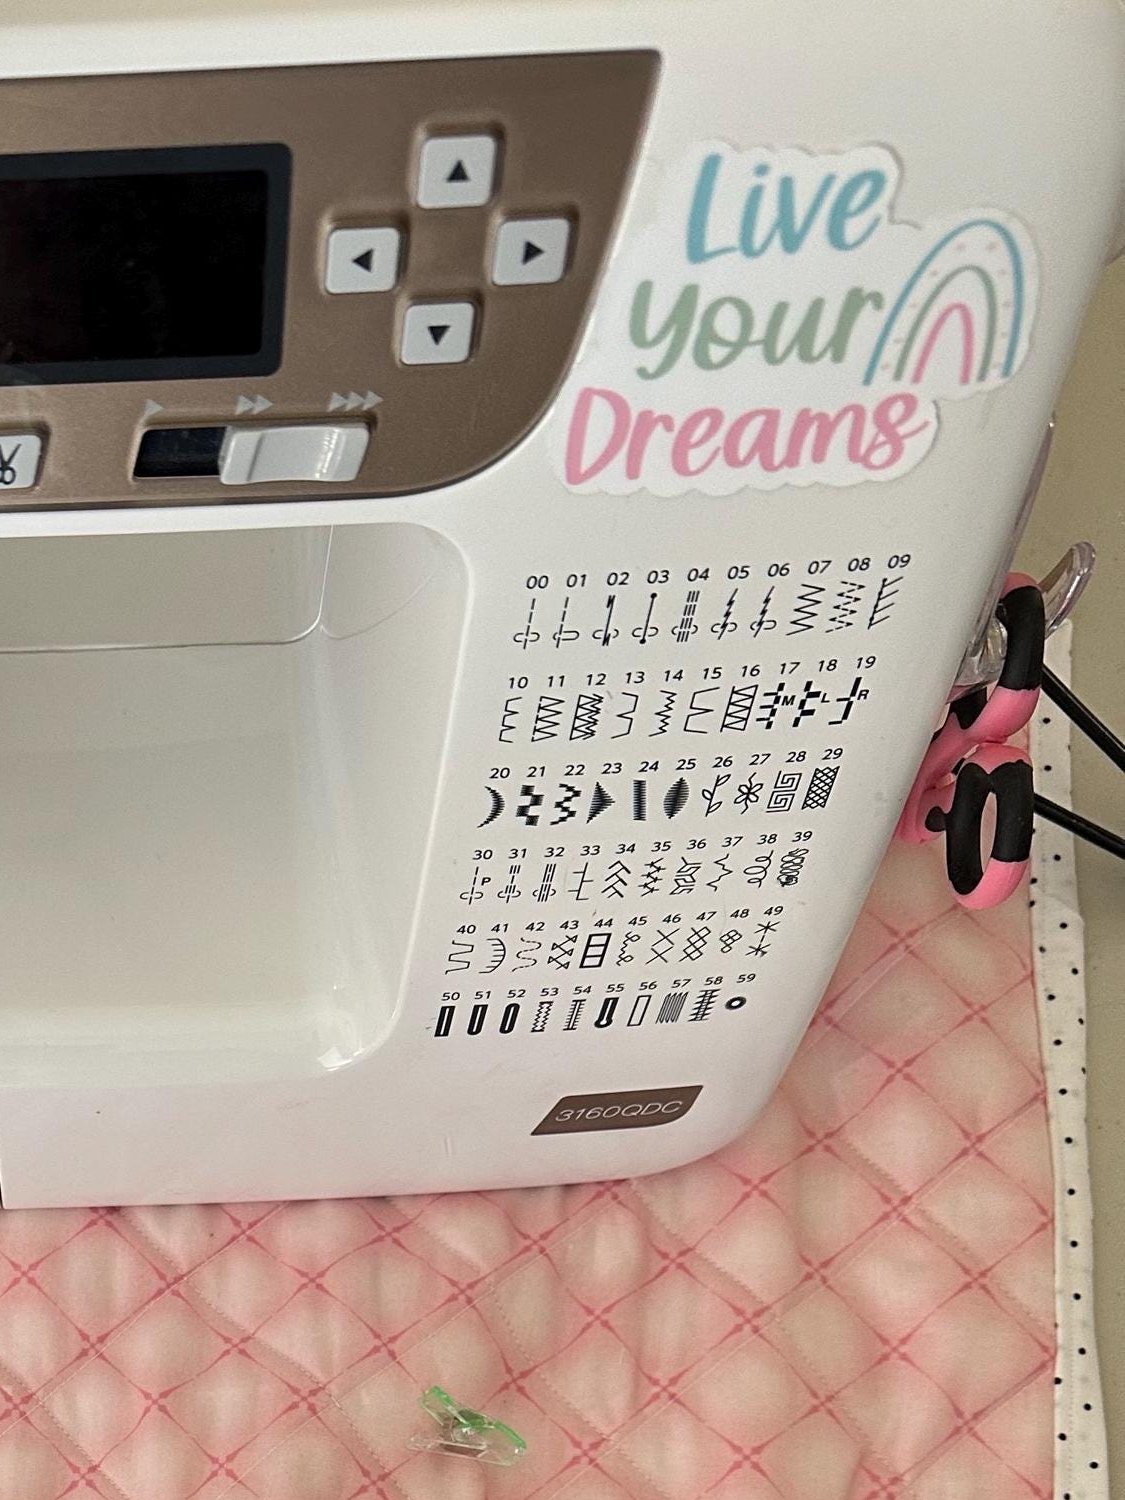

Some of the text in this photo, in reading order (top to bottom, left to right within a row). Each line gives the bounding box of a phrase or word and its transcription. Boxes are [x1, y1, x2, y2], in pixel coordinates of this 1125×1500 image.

[686, 151, 889, 265] Live
[628, 278, 883, 381] your
[564, 386, 929, 486] Dreams
[527, 554, 911, 589] 00 01 02 03 04 05 06 07 08 09
[510, 656, 876, 688] 10 11 12 13 14 15 16 17 18 19
[781, 687, 869, 706] M L R
[489, 748, 843, 779] 20 21 22 23 24 25 26 27 28 29
[473, 831, 812, 860] 30 31 32 33 34 35 36 37 38 39
[481, 877, 491, 886] P
[457, 906, 783, 934] 40 41 42 43 44 45 46 47 48 49
[442, 974, 756, 1001] 50 51 52 53 54 55 56 57 58 59
[554, 1100, 684, 1123] 3160QDC
